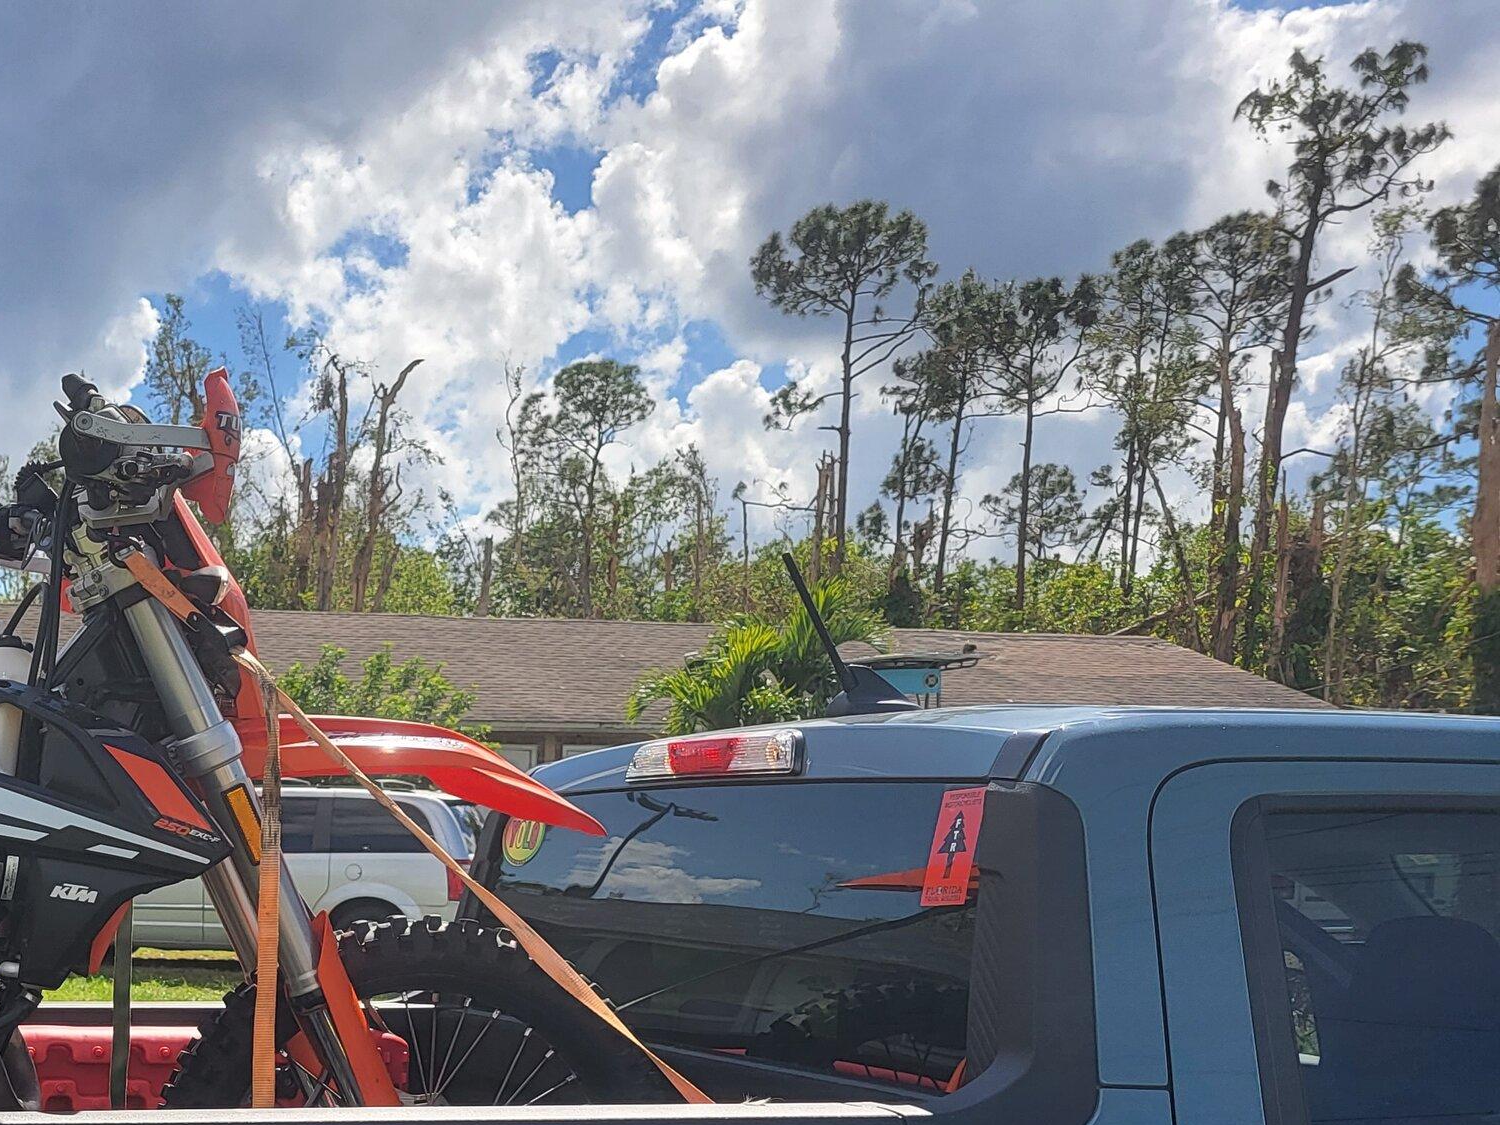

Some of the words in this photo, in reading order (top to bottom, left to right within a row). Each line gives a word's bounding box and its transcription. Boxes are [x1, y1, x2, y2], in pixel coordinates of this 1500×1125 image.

[153, 818, 191, 836] 250
[507, 819, 541, 850] YOLO
[950, 818, 962, 852] FTR
[49, 883, 98, 903] KTM
